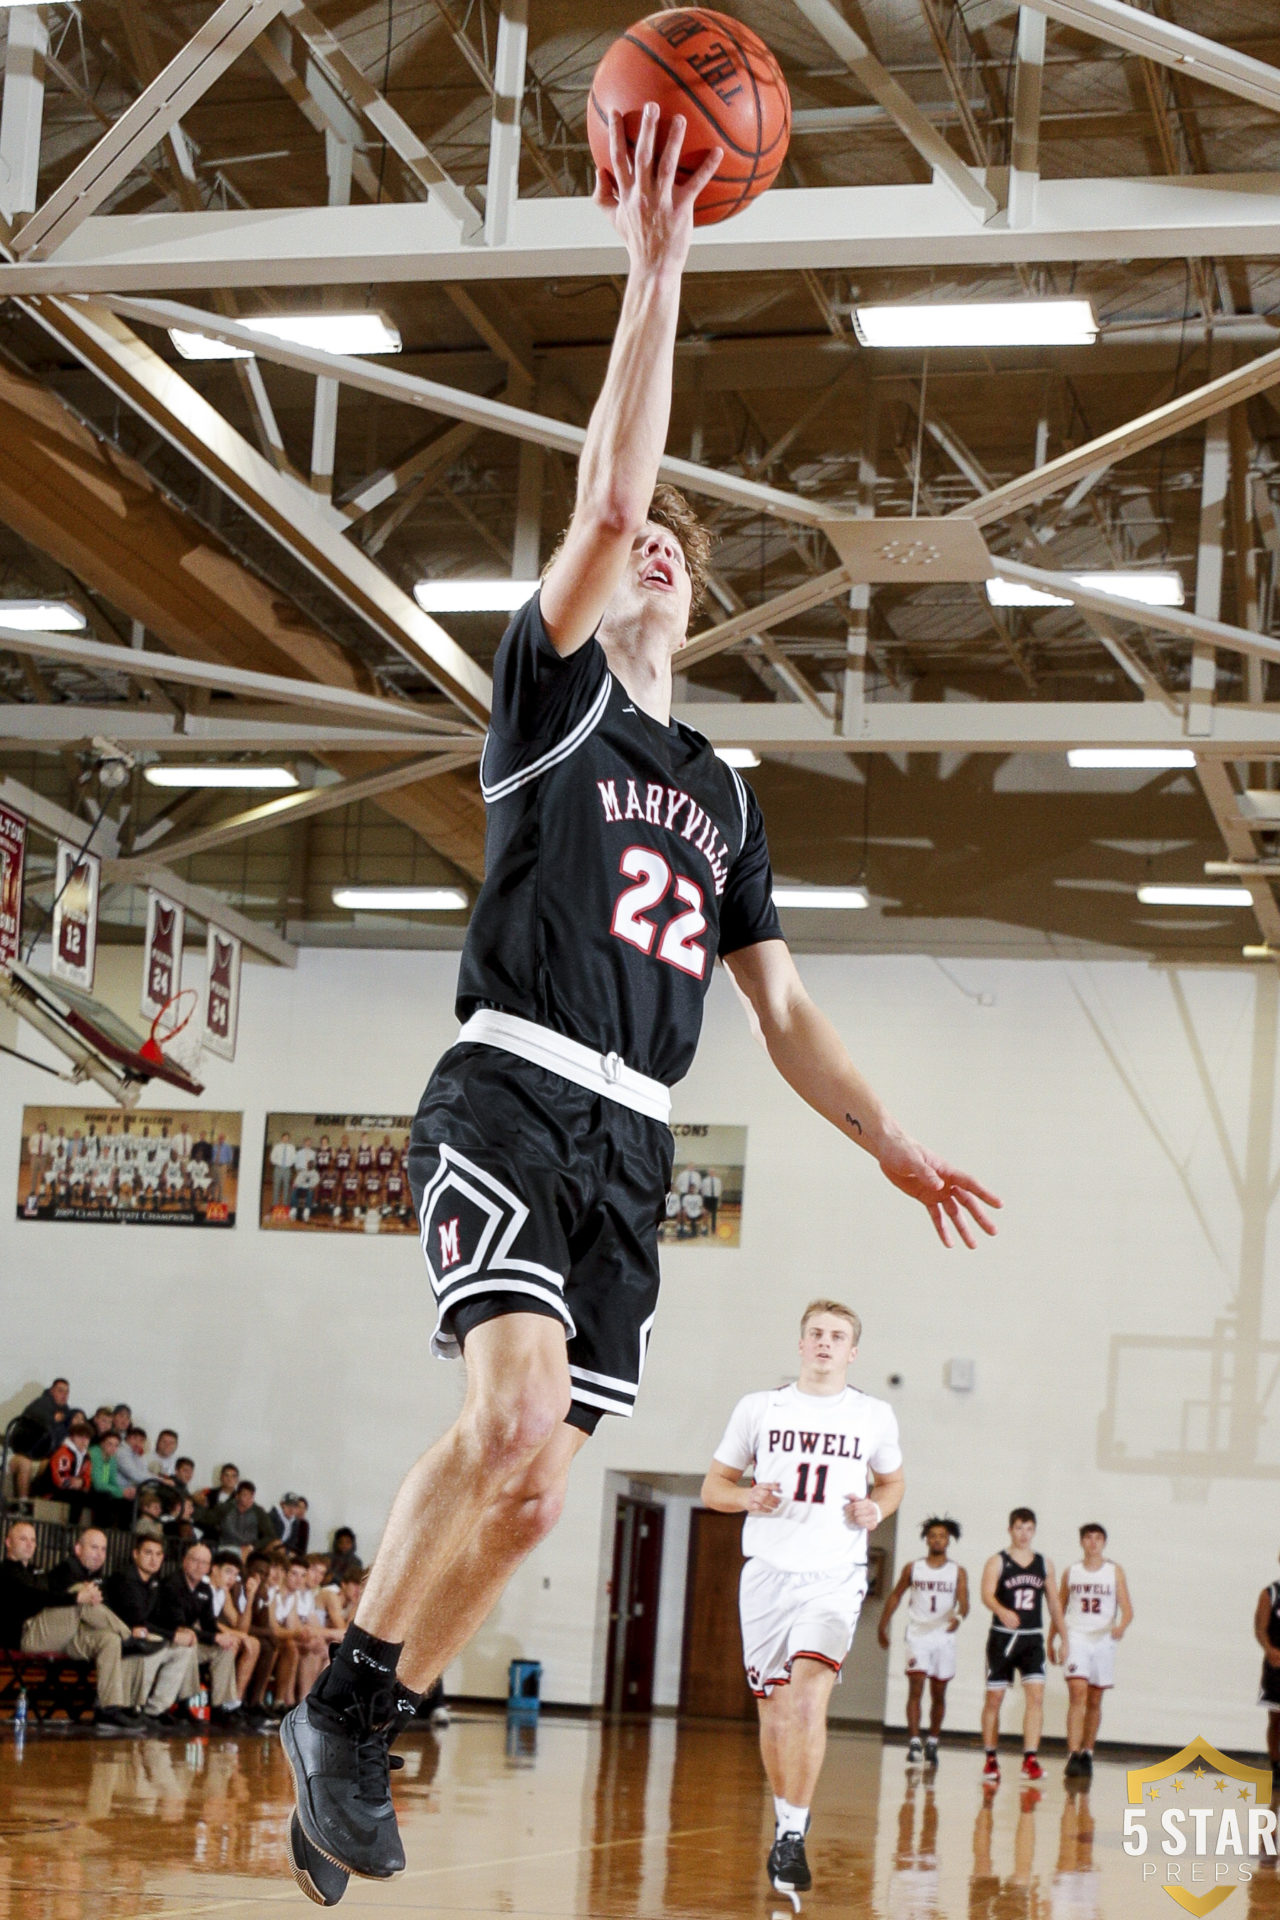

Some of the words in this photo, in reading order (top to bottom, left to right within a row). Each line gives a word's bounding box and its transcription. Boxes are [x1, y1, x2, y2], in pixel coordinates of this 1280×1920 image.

[684, 41, 744, 107] THE
[609, 844, 708, 981] 22
[65, 922, 81, 955] 12
[153, 967, 169, 997] 24
[437, 1215, 462, 1271] M
[769, 1429, 862, 1460] POWELL
[793, 1462, 829, 1504] 11
[913, 1580, 953, 1592] POWELL
[1014, 1588, 1035, 1610] 12
[1070, 1583, 1112, 1596] POWELL
[930, 1594, 937, 1613] 1
[1081, 1597, 1102, 1614] 32
